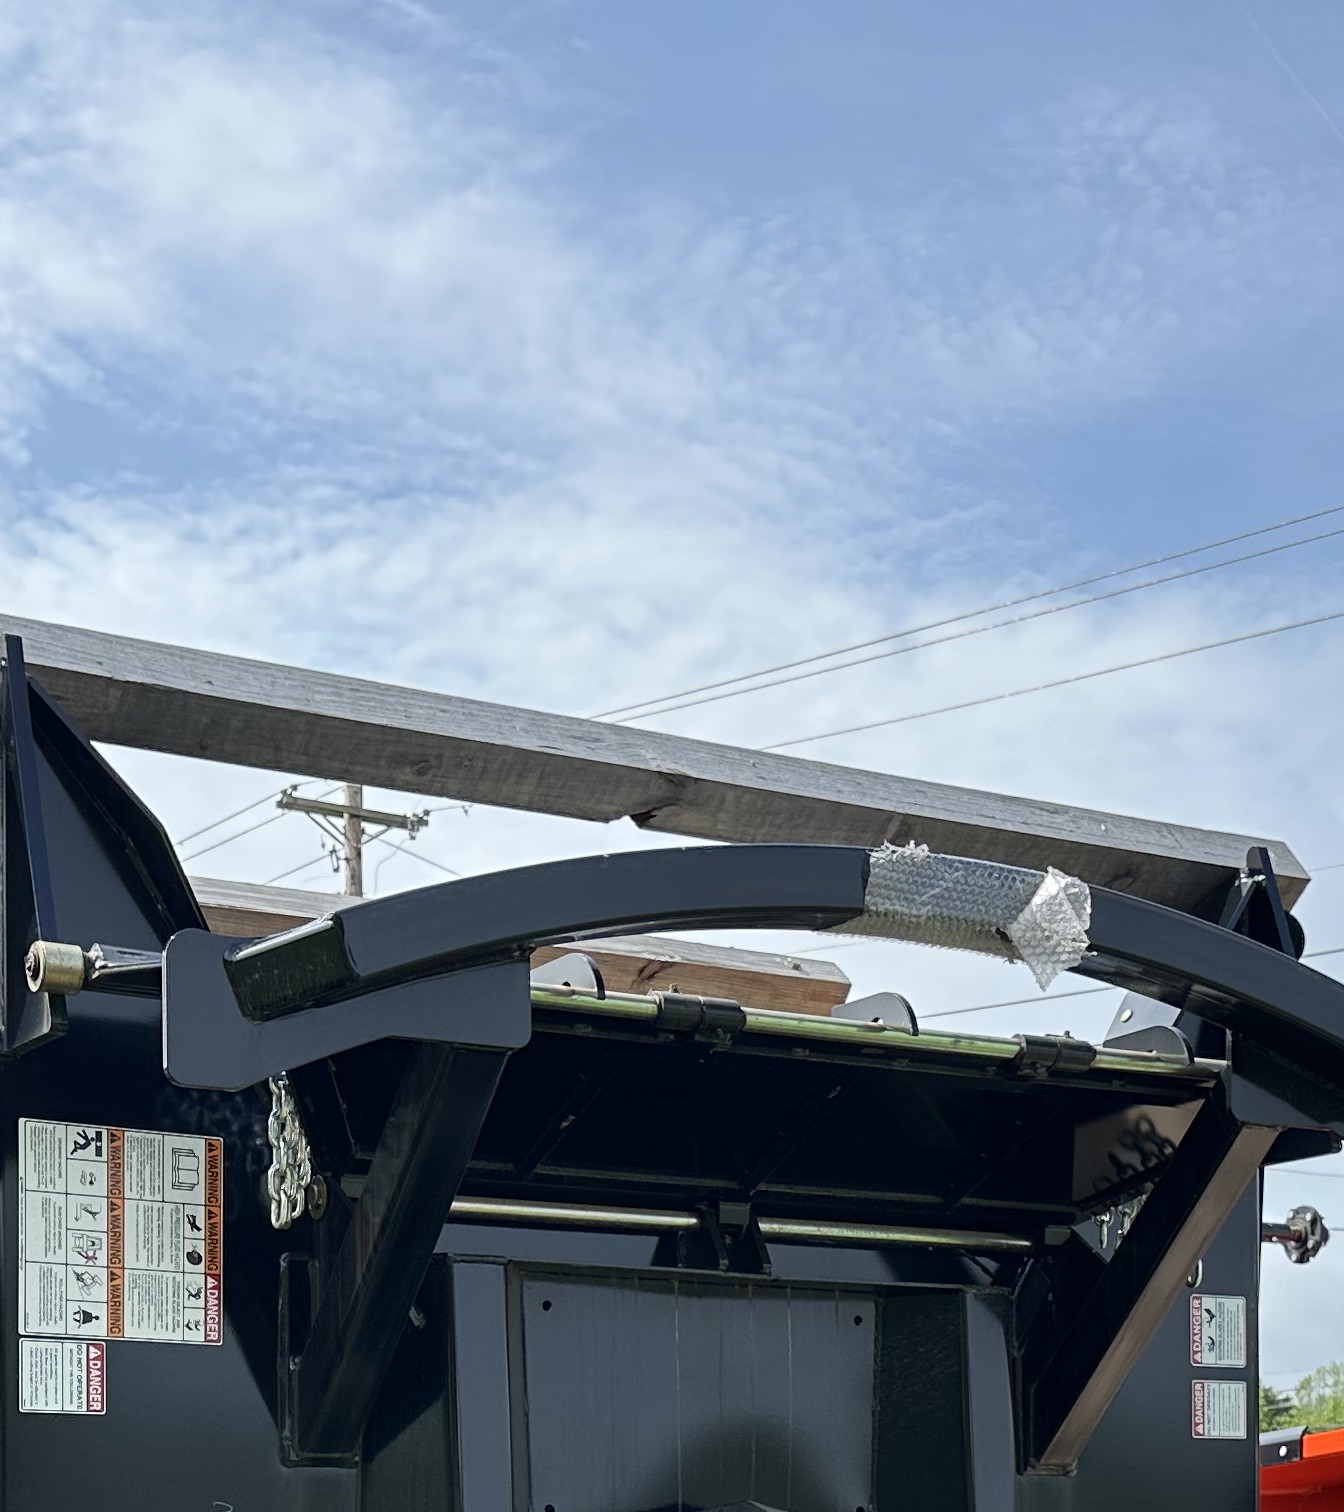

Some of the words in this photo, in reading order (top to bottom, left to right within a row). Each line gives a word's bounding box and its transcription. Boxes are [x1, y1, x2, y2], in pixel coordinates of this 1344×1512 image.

[110, 1145, 121, 1198] WARNING
[208, 1154, 219, 1204] WARNING
[110, 1215, 121, 1265] WARNING
[208, 1221, 219, 1271] WARNING
[110, 1283, 121, 1334] WARNING
[206, 1290, 218, 1341] DANGER
[1192, 1298, 1202, 1351] DANGER
[89, 1361, 102, 1411] DANGER
[1194, 1383, 1204, 1424] DANGER
